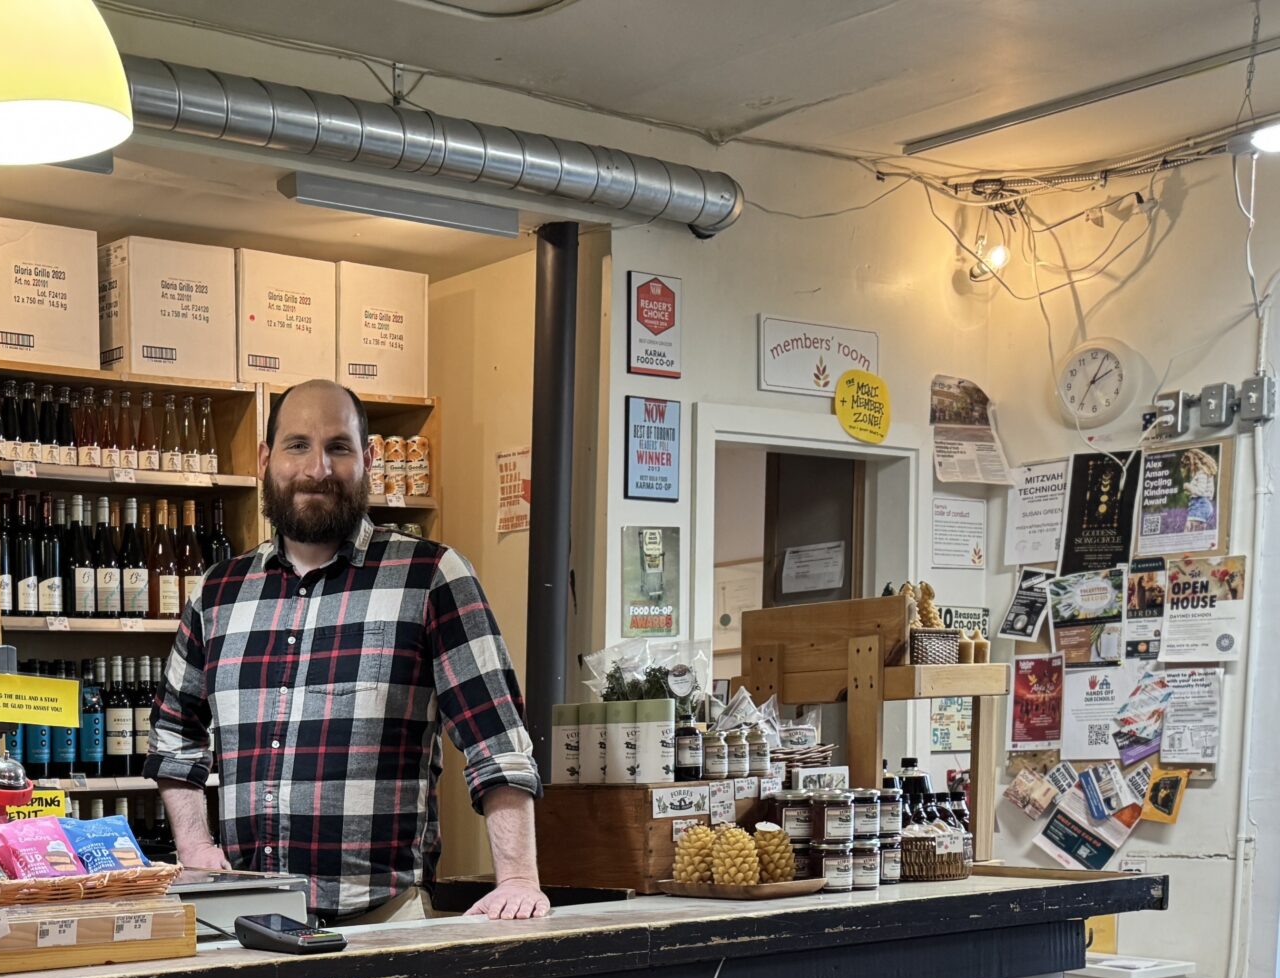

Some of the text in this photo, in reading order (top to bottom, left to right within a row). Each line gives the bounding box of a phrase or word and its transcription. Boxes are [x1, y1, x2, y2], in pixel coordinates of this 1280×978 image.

[14, 265, 66, 280] Gloria Grillo 2023
[161, 280, 208, 294] Gloria Grillo 2023
[268, 291, 311, 305] Gloria Grillo 2023
[364, 310, 378, 320] Gloria
[379, 312, 391, 322] Grillo
[642, 309, 669, 321] CHOICE
[645, 349, 667, 358] KARMA
[770, 332, 871, 371] members' room
[636, 356, 675, 367] FOOD CO-OP
[851, 395, 885, 416] MEMBER
[644, 403, 668, 424] NOW
[853, 412, 883, 429] ZONE!
[633, 424, 675, 442] BEST OF TORONTO
[636, 450, 672, 467] WINNER
[1145, 461, 1162, 470] Alex
[1024, 472, 1064, 485] MITZVAH
[1144, 470, 1170, 478] Amaro
[636, 482, 655, 490] KARMA
[1144, 479, 1172, 489] Cycling
[1144, 487, 1179, 497] Kindness
[1143, 496, 1167, 506] Award
[1074, 537, 1093, 545] SONG
[1172, 580, 1210, 596] OPEN
[1170, 595, 1217, 611] HOUSE
[629, 605, 673, 616] FOOD CO-OP
[954, 610, 981, 620] Reasons
[629, 615, 673, 630] AWARDS
[953, 620, 981, 631] CO-OPS
[1048, 771, 1068, 796] SUDAN
